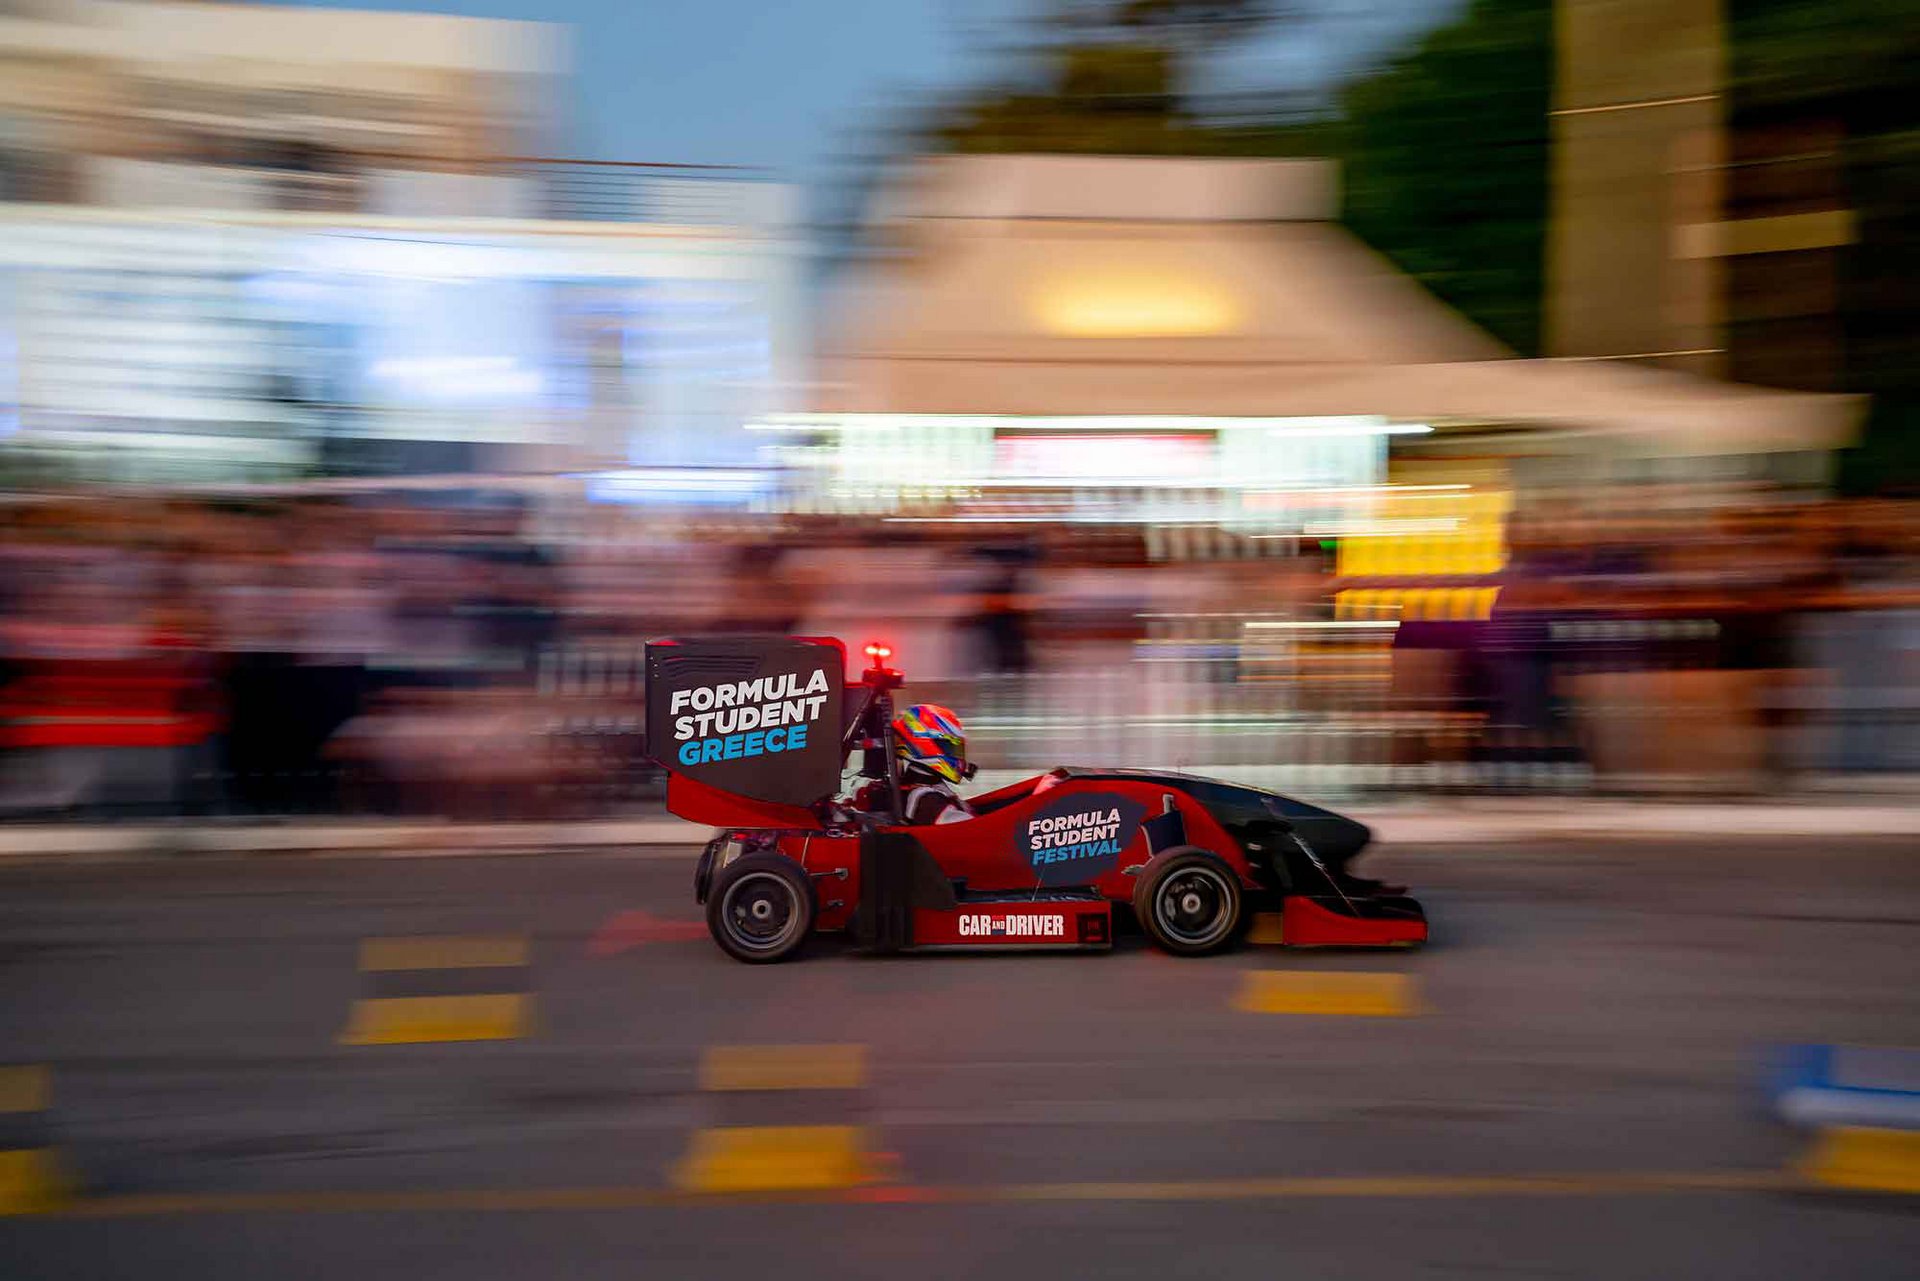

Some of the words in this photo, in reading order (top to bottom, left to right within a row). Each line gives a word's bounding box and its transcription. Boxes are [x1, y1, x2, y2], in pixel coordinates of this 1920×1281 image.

[670, 669, 829, 715] FORMULA
[673, 695, 828, 740] STUDENT
[678, 724, 808, 766] GREECE
[1028, 808, 1121, 836] FORMULA
[1030, 823, 1120, 850] STUDENT
[1032, 838, 1122, 866] FESTIVAL
[959, 914, 991, 936] CAR
[992, 920, 1005, 930] AND
[1005, 914, 1064, 936] DRIVER
